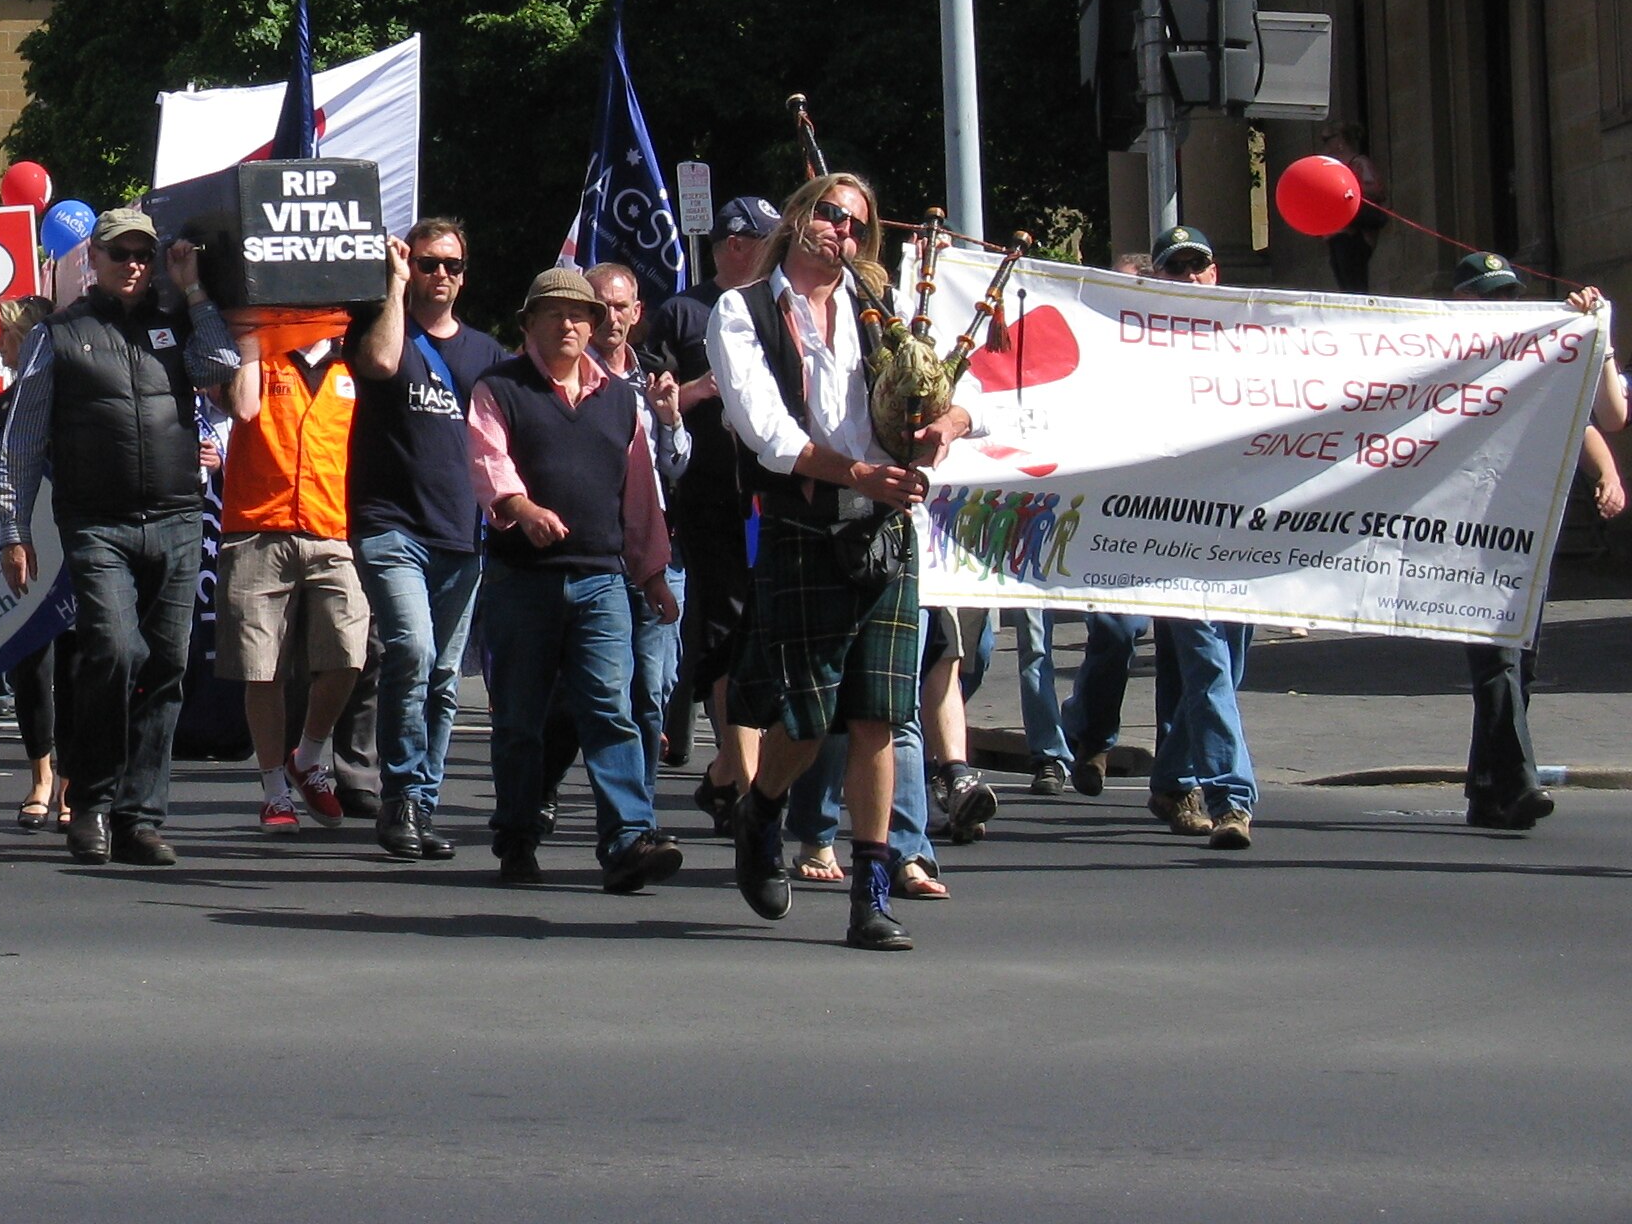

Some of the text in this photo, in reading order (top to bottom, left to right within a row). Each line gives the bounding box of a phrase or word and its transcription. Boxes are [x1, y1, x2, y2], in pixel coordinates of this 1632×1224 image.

[281, 170, 337, 197] RIP
[55, 209, 90, 239] HACSU
[262, 200, 372, 232] VITAL
[243, 234, 387, 263] SERVICES
[1119, 309, 1584, 364] DEFENDING TASMANIA'S
[1188, 375, 1509, 417] PUBLIC SERVICES
[1243, 431, 1440, 469] SINCE 1897
[1101, 494, 1535, 555] COMMUNITY & PUBLIC SECTOR UNION
[1090, 534, 1524, 590] State Public Services Federation Tasmania Inc
[1082, 571, 1249, 596] cpsu@tas.cpsu.com.au
[1377, 595, 1517, 623] www.cpsu.com.au
